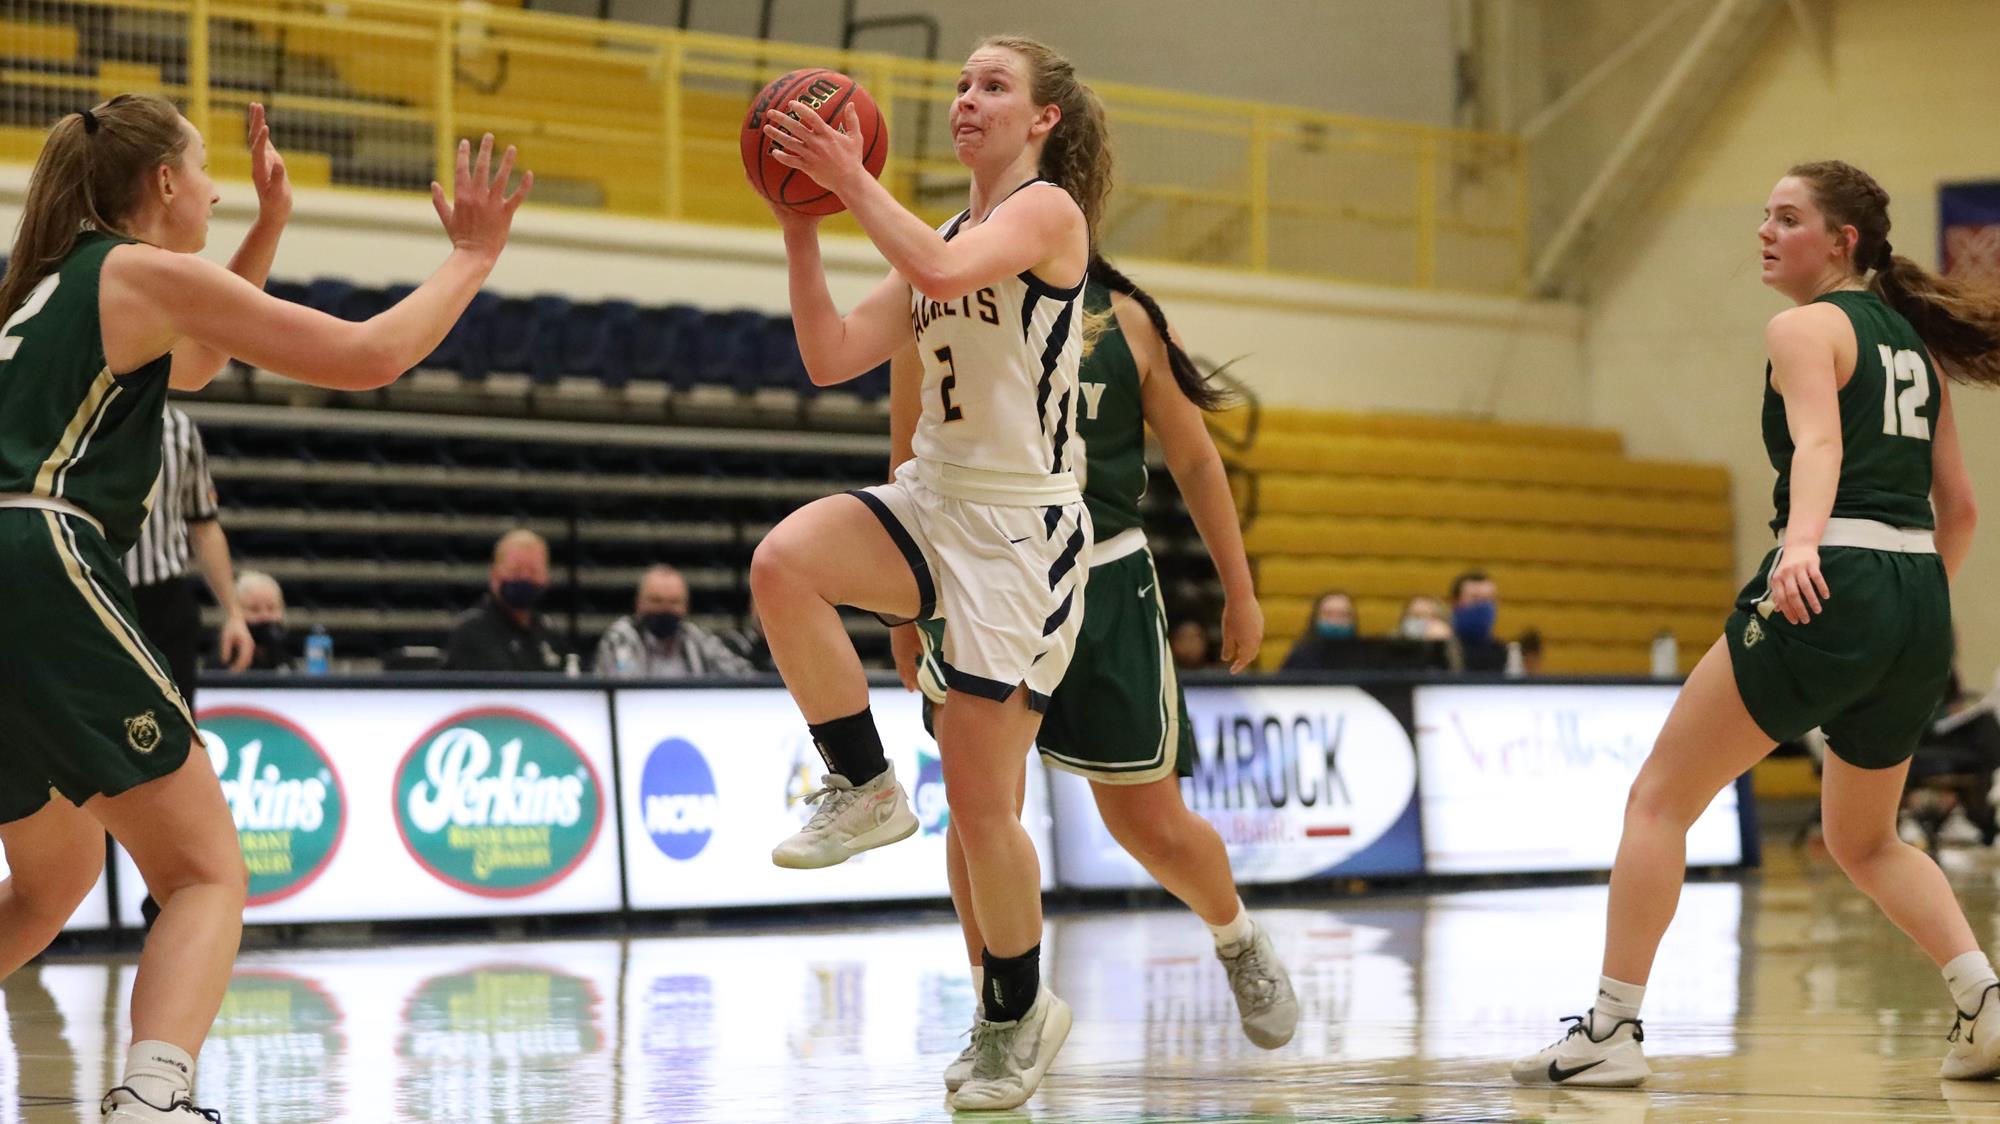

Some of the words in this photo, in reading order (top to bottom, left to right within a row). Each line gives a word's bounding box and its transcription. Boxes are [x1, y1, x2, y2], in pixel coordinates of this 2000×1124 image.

[767, 79, 842, 156] Wisn
[912, 287, 1000, 342] ACKETS
[933, 345, 965, 422] 2
[1877, 344, 1931, 441] 12
[407, 727, 584, 833] Perkins
[1187, 713, 1352, 810] MROCK
